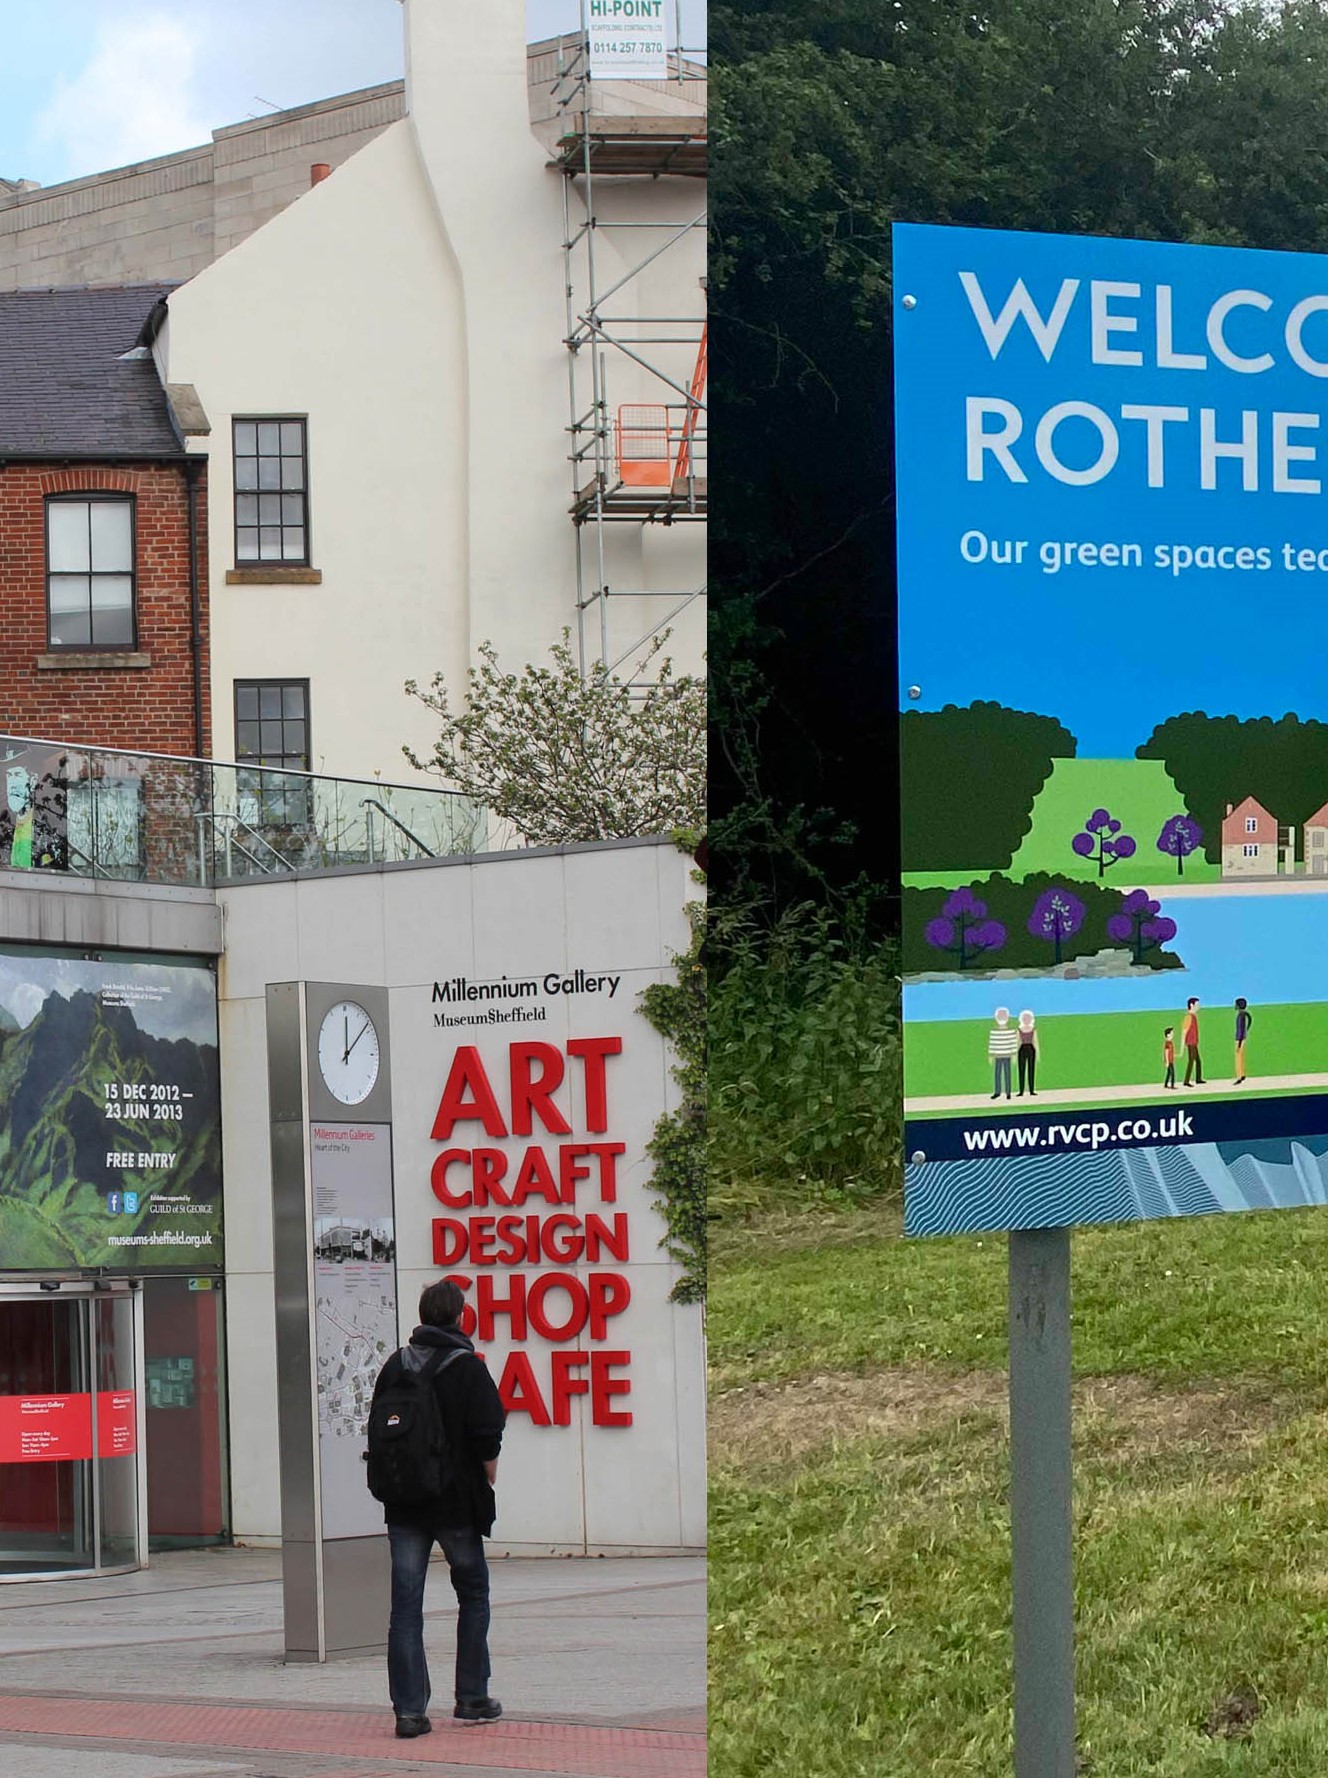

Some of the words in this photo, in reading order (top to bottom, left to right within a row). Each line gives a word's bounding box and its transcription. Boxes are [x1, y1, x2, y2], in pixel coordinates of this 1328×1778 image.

[591, 0, 662, 17] HI-POINT
[594, 42, 617, 53] 0114
[620, 42, 637, 53] 257
[639, 42, 663, 53] 7870
[960, 531, 1028, 563] Our
[1039, 541, 1142, 574] green
[1154, 545, 1271, 576] spaces
[432, 975, 538, 1003] Millennium
[543, 969, 621, 999] Gallery
[104, 1084, 119, 1100] 15
[123, 1084, 147, 1100] DEC
[150, 1085, 180, 1101] 2012
[430, 1036, 623, 1140] ART
[105, 1103, 122, 1119] 23
[123, 1104, 150, 1120] JUN
[153, 1104, 184, 1120] 2013
[963, 1110, 1195, 1151] www.rvcp.co.uk
[106, 1152, 135, 1168] FREE
[138, 1153, 177, 1169] ENTRY
[431, 1142, 626, 1209] CRAFT
[150, 1204, 172, 1214] GUILD
[186, 1204, 213, 1214] GEORGE
[108, 1230, 213, 1248] museums-sheffield.org.uk
[432, 1212, 629, 1266] DESIGN
[475, 1350, 633, 1427] AFE
